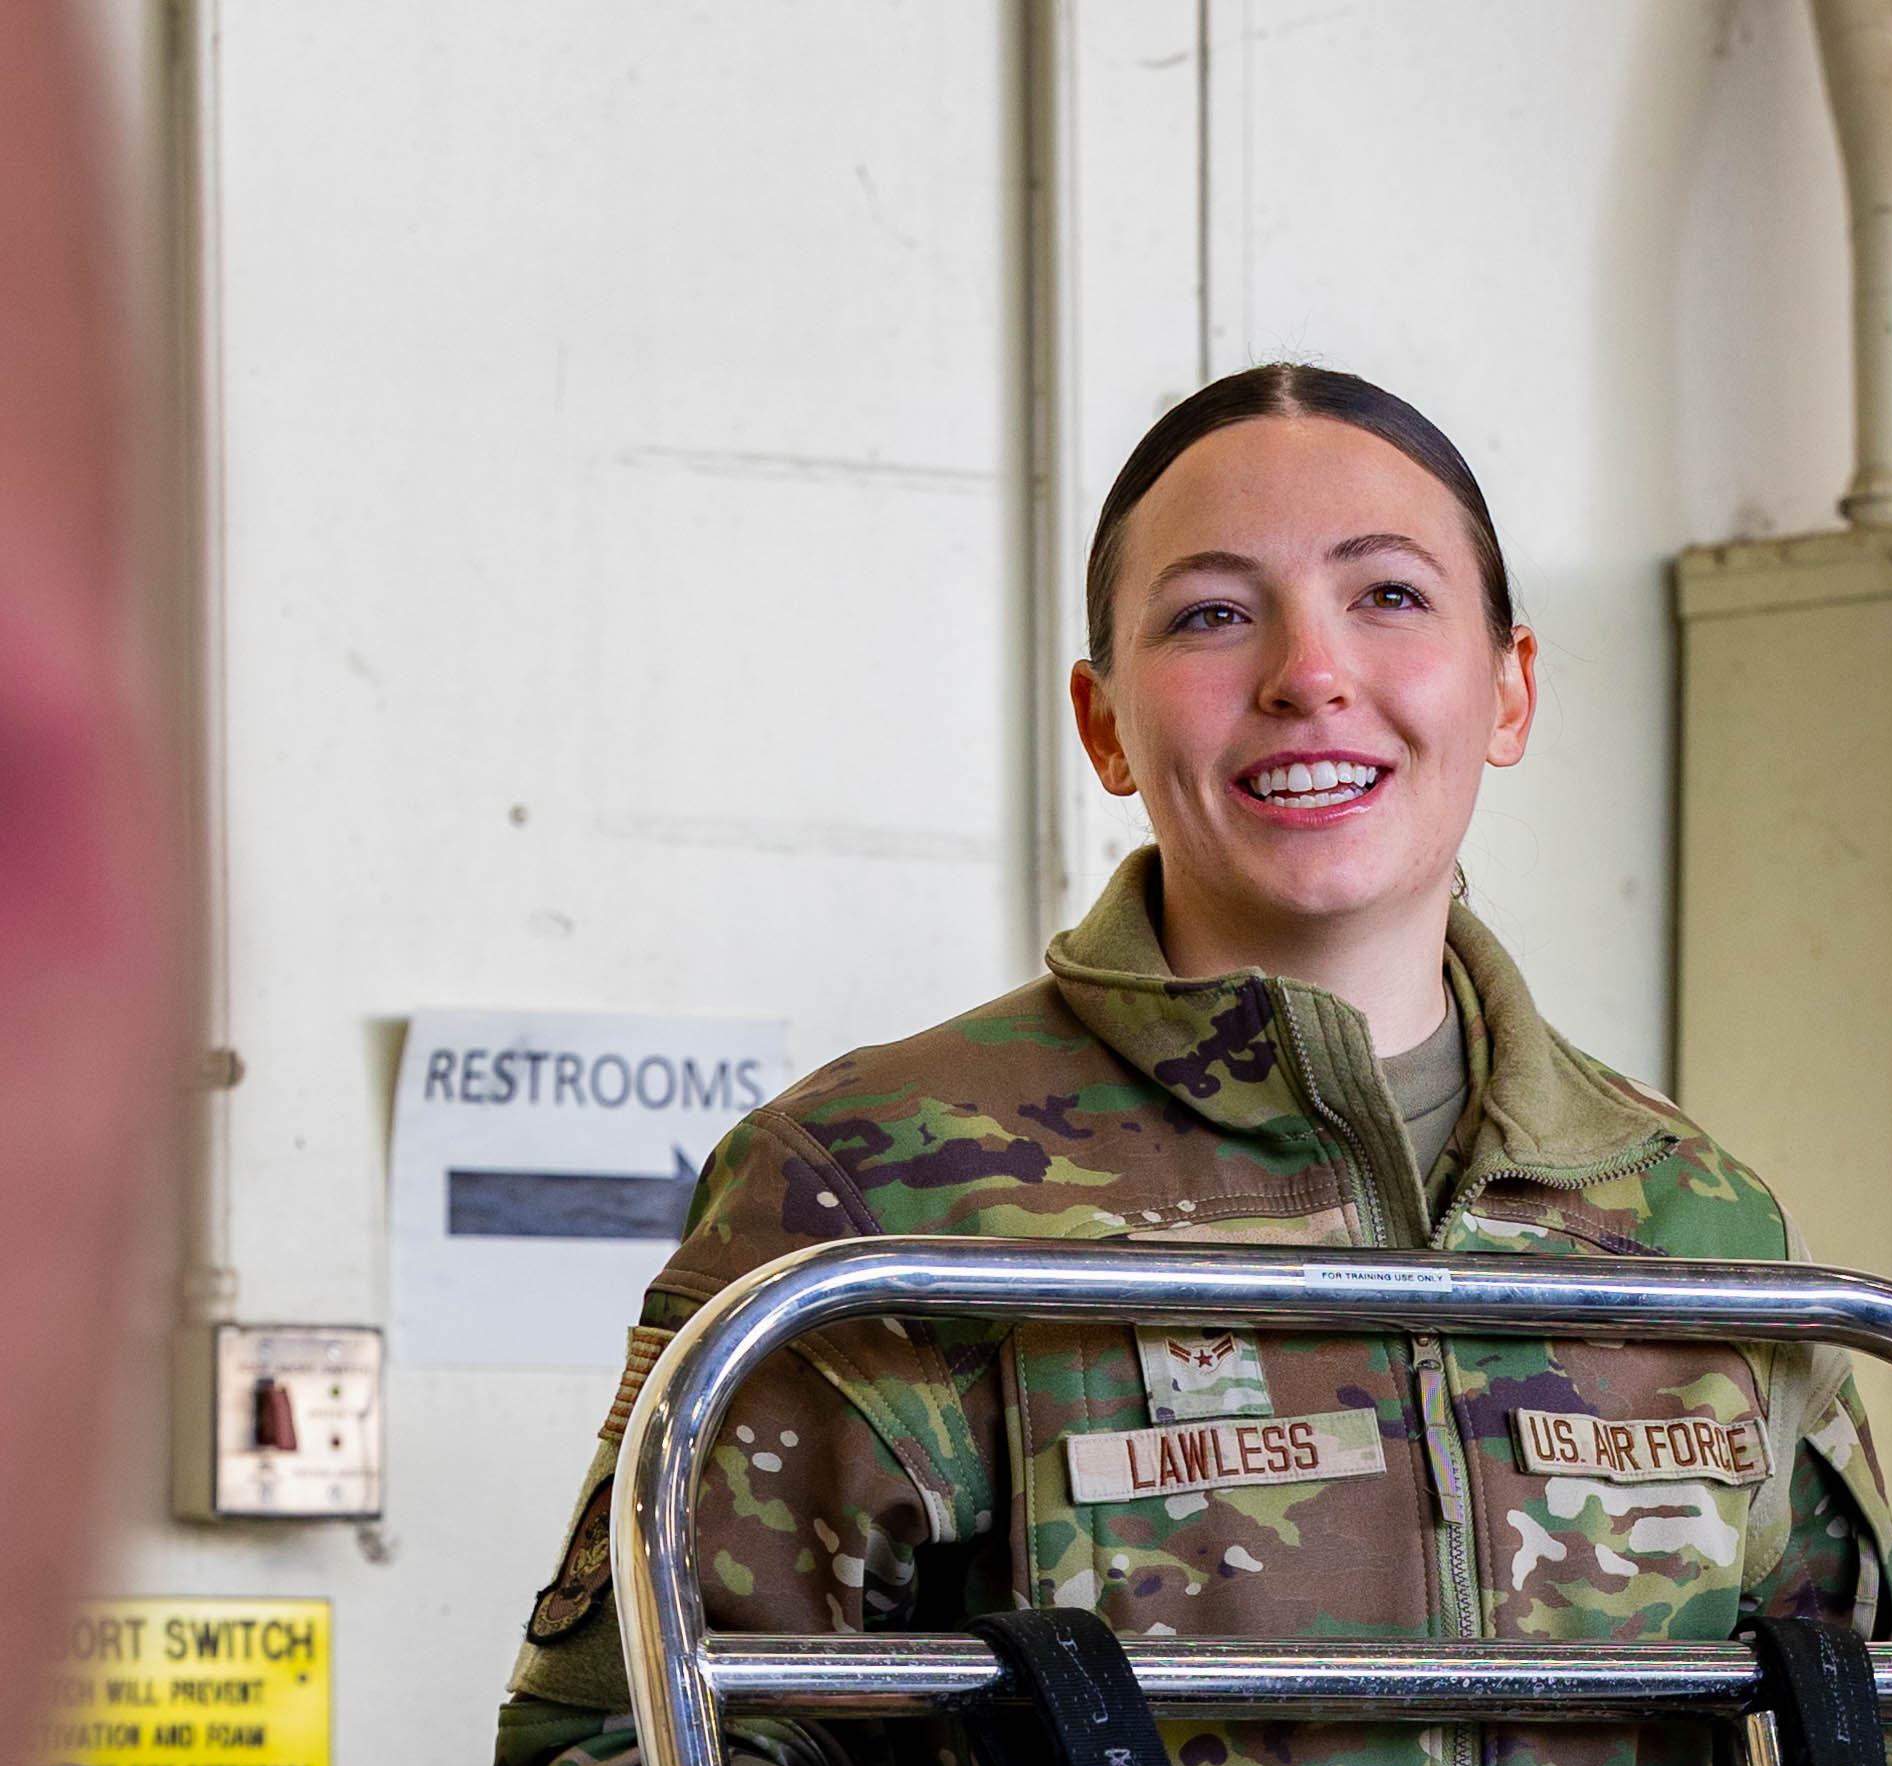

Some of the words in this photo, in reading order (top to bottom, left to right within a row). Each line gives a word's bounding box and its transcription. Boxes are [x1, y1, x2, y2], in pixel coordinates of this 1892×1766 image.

[424, 1048, 767, 1112] RESTROOMS
[1321, 1271, 1342, 1280] FOR
[1345, 1272, 1392, 1281] TRAINING
[1395, 1273, 1415, 1282] USE
[1417, 1274, 1444, 1283] ONLY
[1126, 1422, 1319, 1489] LAWLESS
[1528, 1416, 1587, 1463] U.S.
[1592, 1420, 1642, 1472] AIR
[1645, 1422, 1754, 1472] FORCE
[71, 1617, 147, 1661] ORT
[165, 1618, 314, 1661] SWITCH
[106, 1680, 157, 1707] WILL
[170, 1679, 266, 1707] PREVENT
[152, 1723, 196, 1749] AND
[206, 1724, 267, 1748] FOAM
